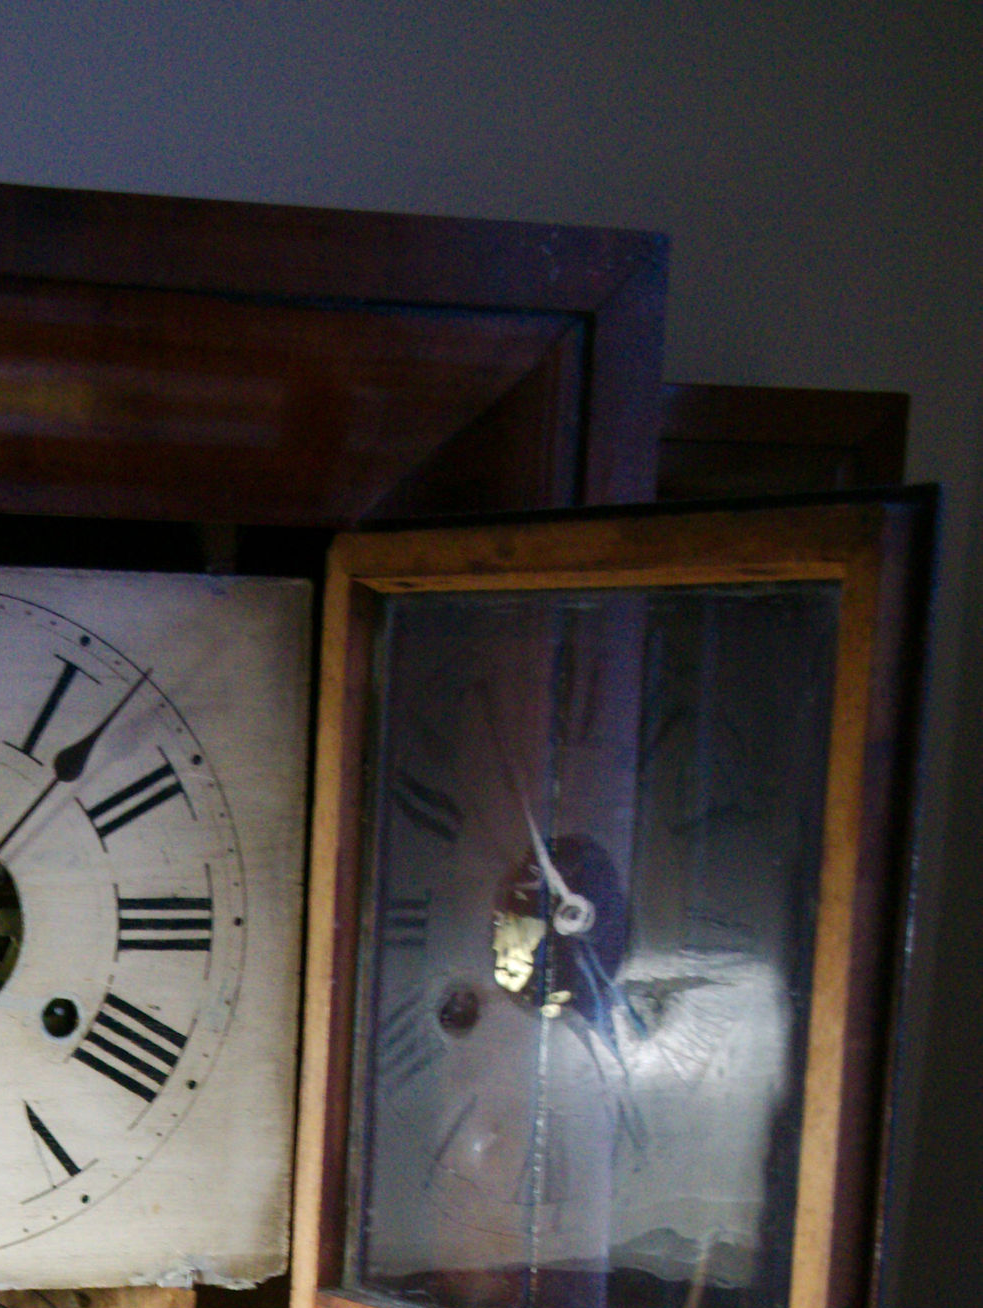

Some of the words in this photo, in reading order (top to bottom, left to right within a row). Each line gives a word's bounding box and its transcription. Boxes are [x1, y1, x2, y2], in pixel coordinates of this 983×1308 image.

[74, 745, 198, 854] II
[112, 863, 214, 981] III
[63, 974, 198, 1131] IIII
[20, 1098, 99, 1205] V
